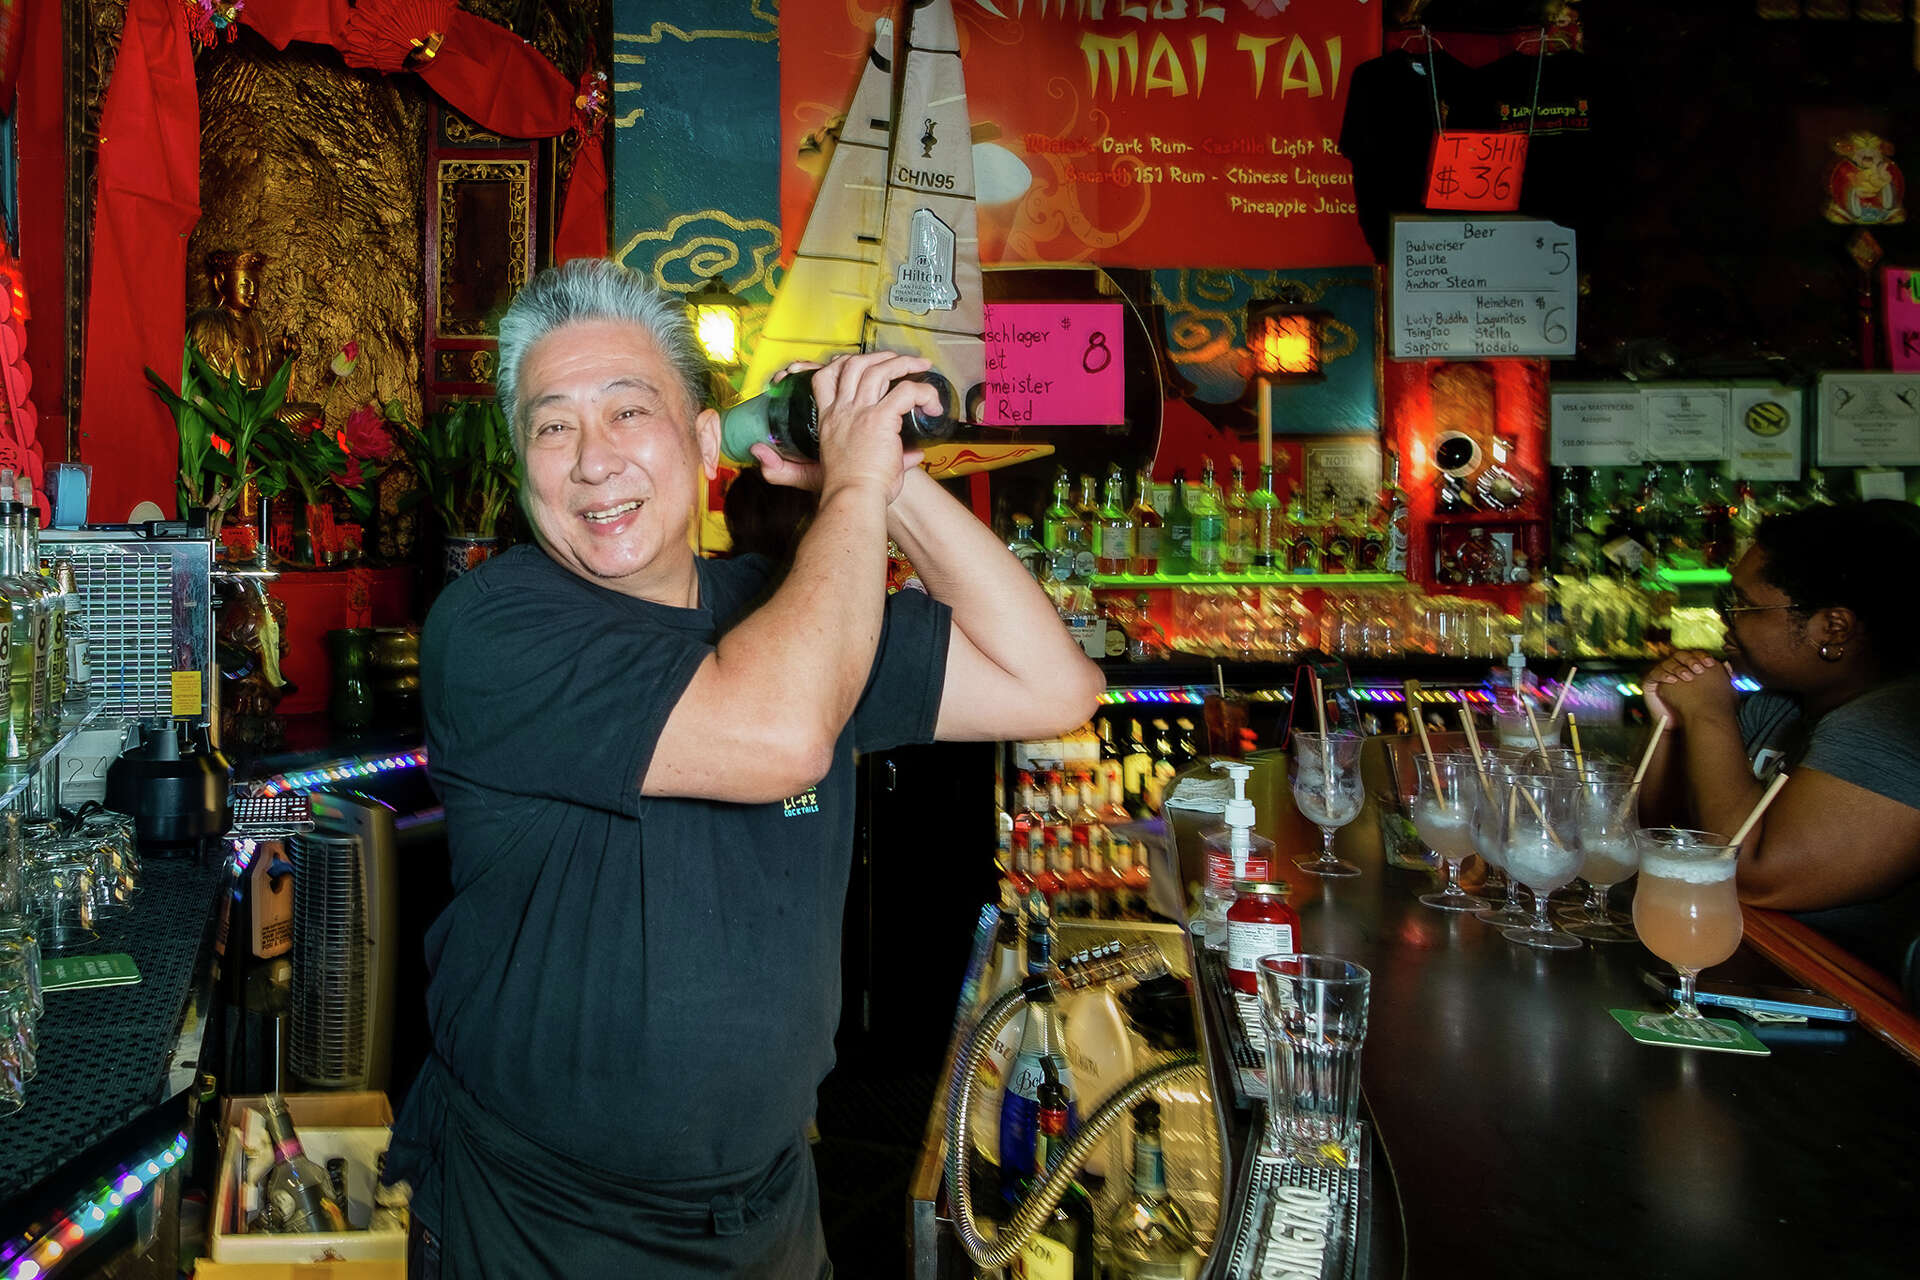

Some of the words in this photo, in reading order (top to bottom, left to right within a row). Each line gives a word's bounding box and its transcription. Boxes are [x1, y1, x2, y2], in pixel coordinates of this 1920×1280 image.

[1079, 32, 1207, 101] MAI
[1236, 33, 1342, 100] TAI
[1102, 137, 1143, 154] Dark
[1271, 137, 1316, 158] Light
[897, 167, 956, 190] CHN95
[1134, 166, 1164, 184] 151
[1170, 167, 1205, 184] Rum
[1226, 167, 1289, 184] Chinese
[1231, 196, 1307, 218] Pineapple
[1314, 196, 1356, 215] Juice
[1463, 223, 1498, 240] Beer
[1406, 240, 1466, 252] Budweiser
[1406, 255, 1427, 267] Bud
[902, 268, 943, 283] Hilton
[1406, 267, 1449, 278] Corona
[1405, 280, 1441, 291] Anchor
[1446, 277, 1488, 289] Steam
[1476, 296, 1524, 309] Heineken
[1406, 314, 1433, 327] Lucky
[1475, 313, 1527, 329] Lagunitas
[1475, 327, 1512, 339] Stella
[1404, 341, 1450, 355] Sapporo
[1475, 340, 1520, 353] Modelo
[998, 400, 1033, 421] Red
[783, 804, 820, 817] COCKTAILS
